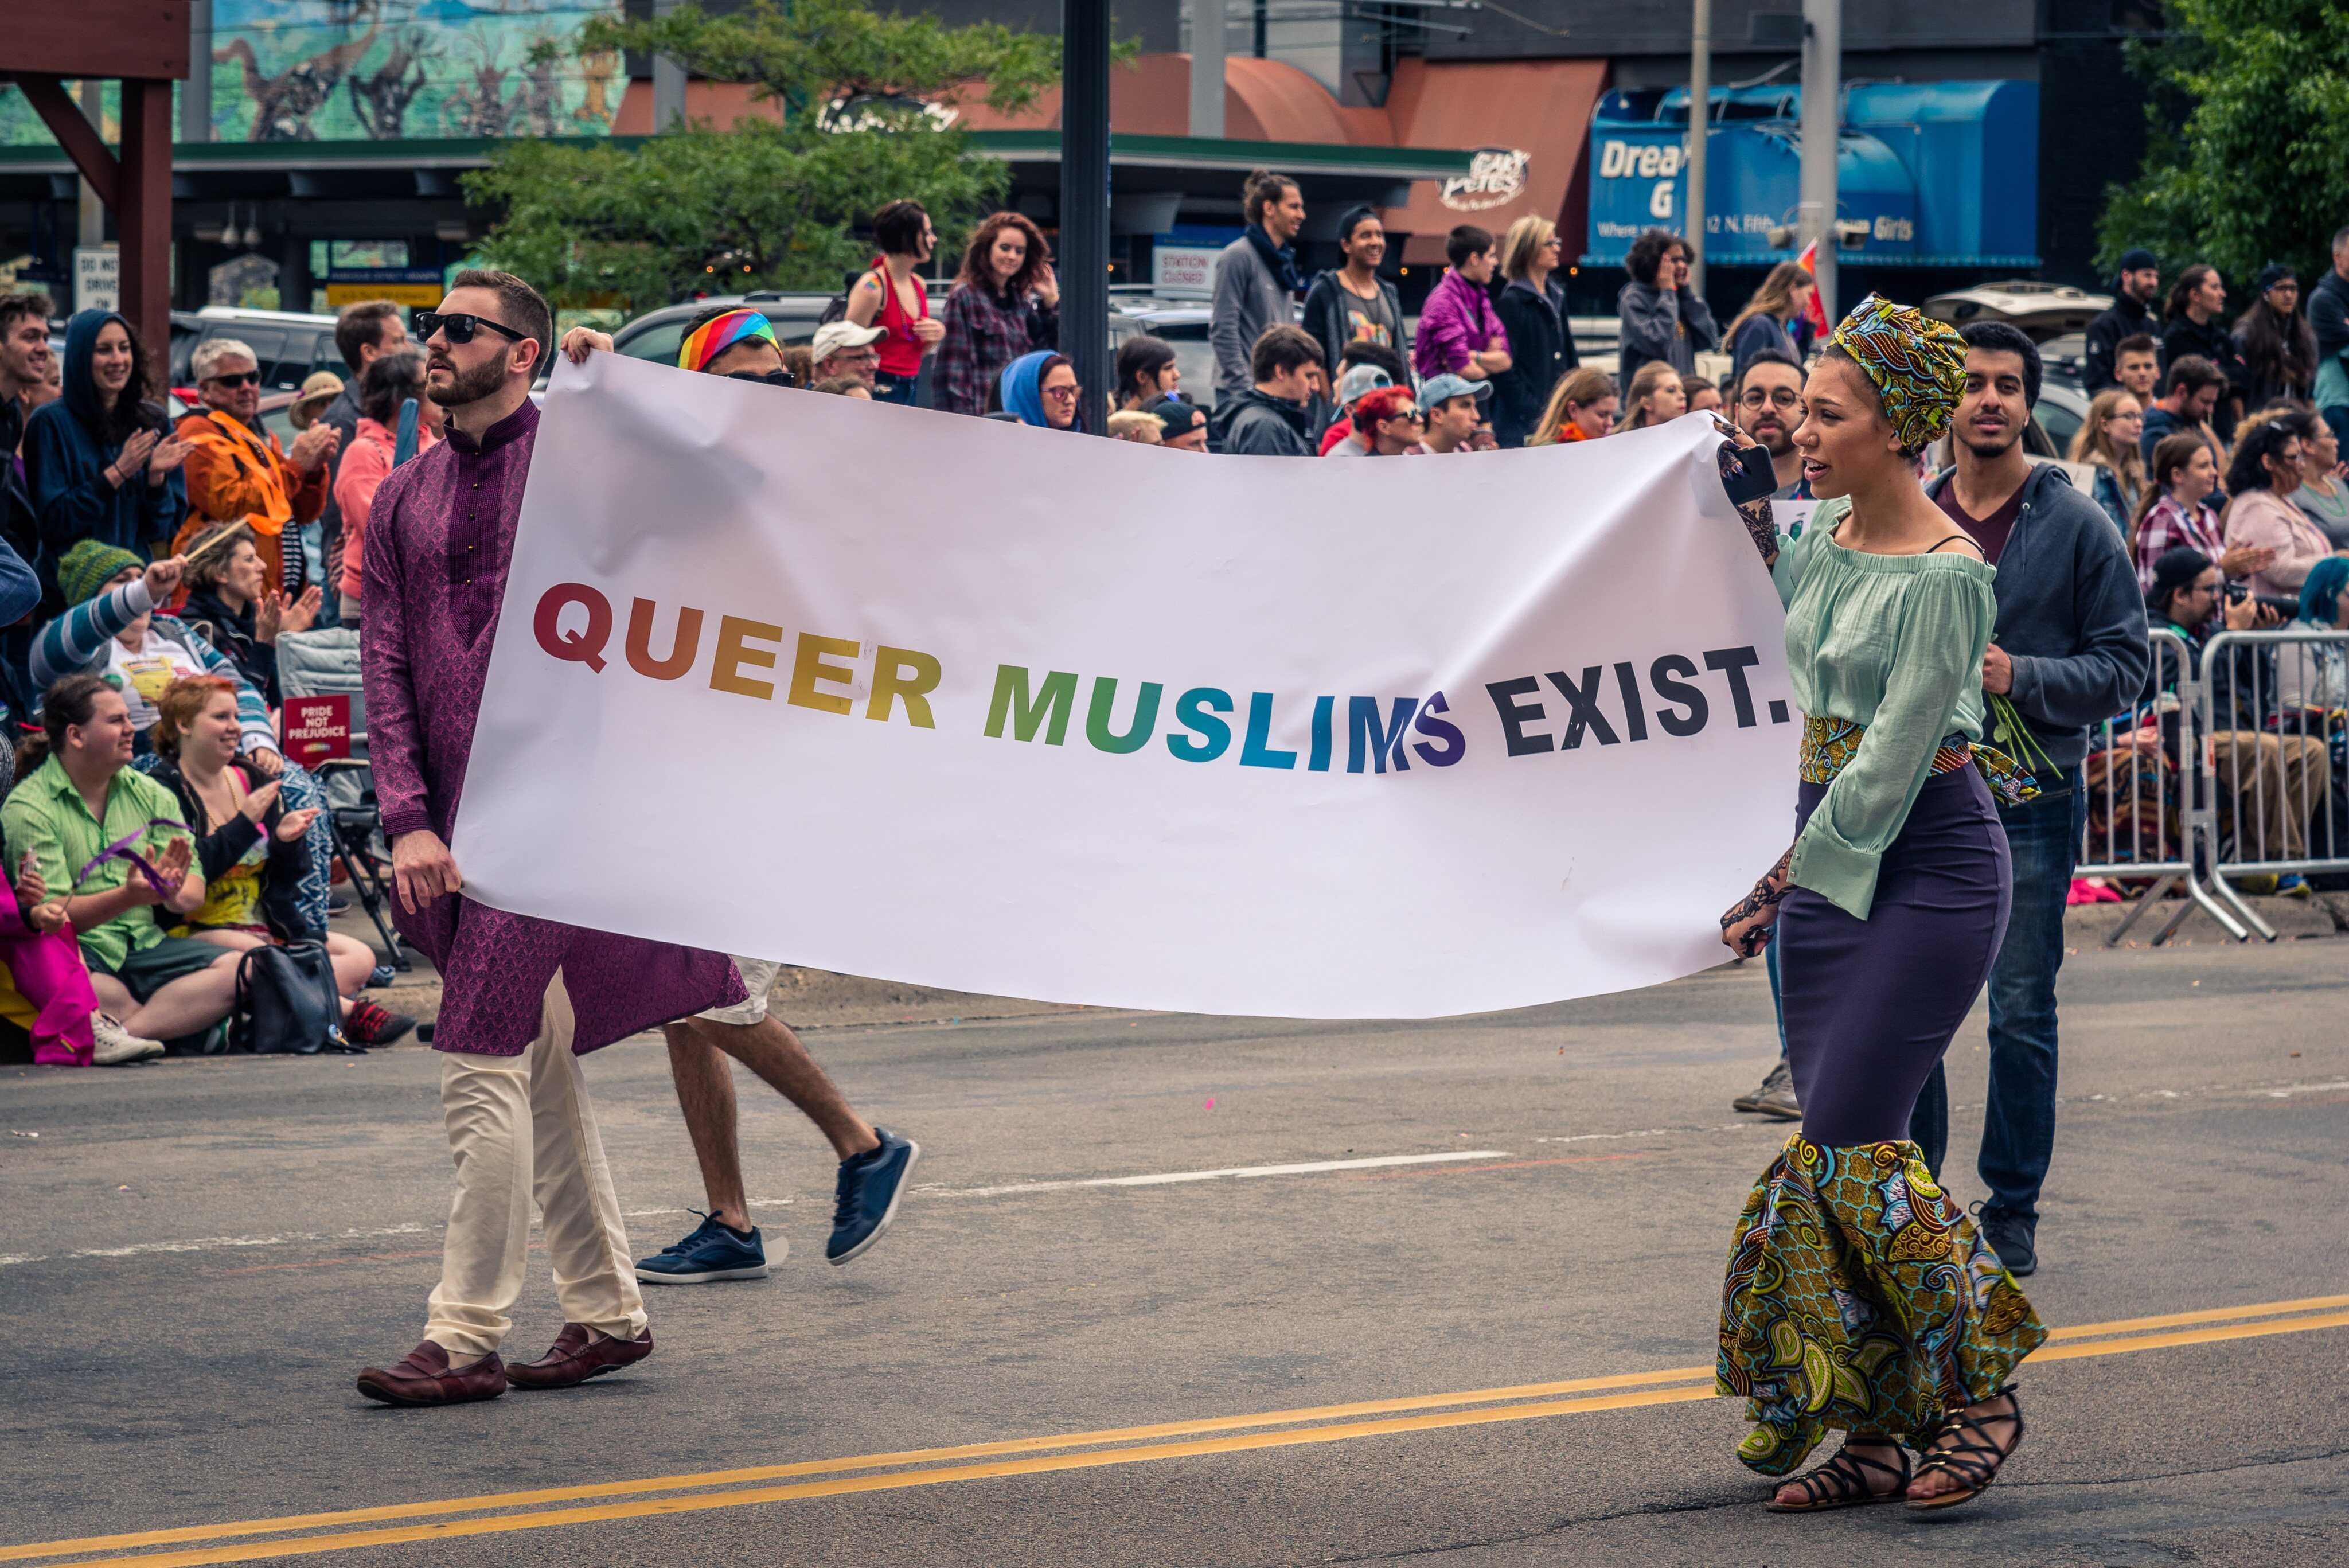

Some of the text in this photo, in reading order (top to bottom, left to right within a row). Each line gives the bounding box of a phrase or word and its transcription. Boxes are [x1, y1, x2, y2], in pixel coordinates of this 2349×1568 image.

[1599, 139, 1683, 178] Drea
[1161, 254, 1209, 268] STATION
[1161, 270, 1206, 284] CLOSED
[533, 583, 1790, 774] QUEER MUSLIMS EXIST.
[301, 705, 333, 718] PRIDE
[305, 716, 329, 728] NOT
[288, 724, 346, 740] PREJUDICE
